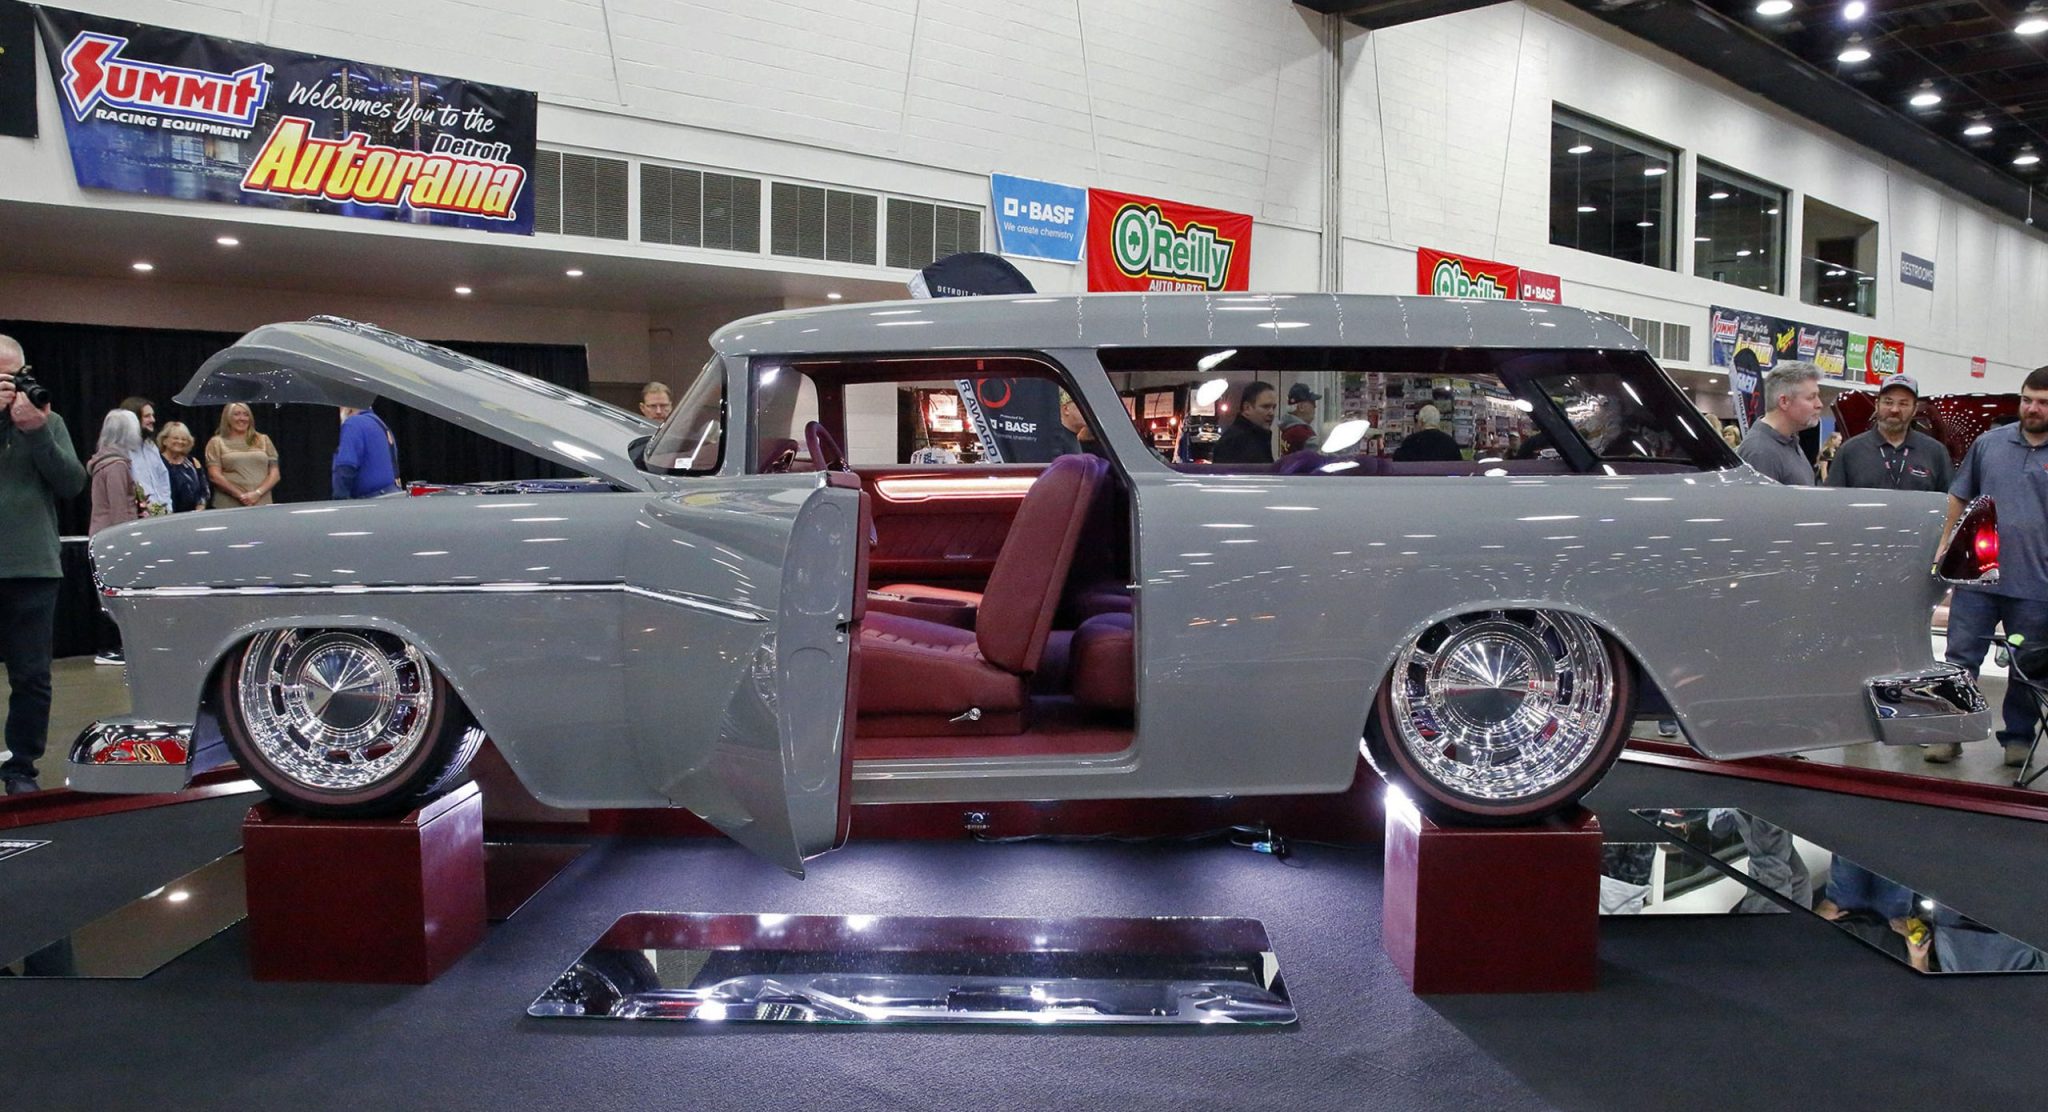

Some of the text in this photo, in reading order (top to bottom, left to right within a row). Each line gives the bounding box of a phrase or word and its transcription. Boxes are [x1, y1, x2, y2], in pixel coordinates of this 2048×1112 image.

[287, 80, 497, 134] Welcomes You to the
[95, 108, 252, 140] RACING EQUIPMENT
[433, 134, 511, 163] Detroit
[242, 117, 525, 218] Autorama
[1029, 201, 1075, 225] BASF
[1003, 221, 1074, 242] We create chemistry
[1115, 209, 1231, 287] O'Reilly
[1901, 261, 1934, 282] RESTROOMS
[937, 285, 969, 297] DETROIT
[1149, 279, 1173, 292] AUTO
[1535, 286, 1556, 301] BASF
[966, 396, 997, 457] AWARD
[1005, 421, 1037, 433] BASF
